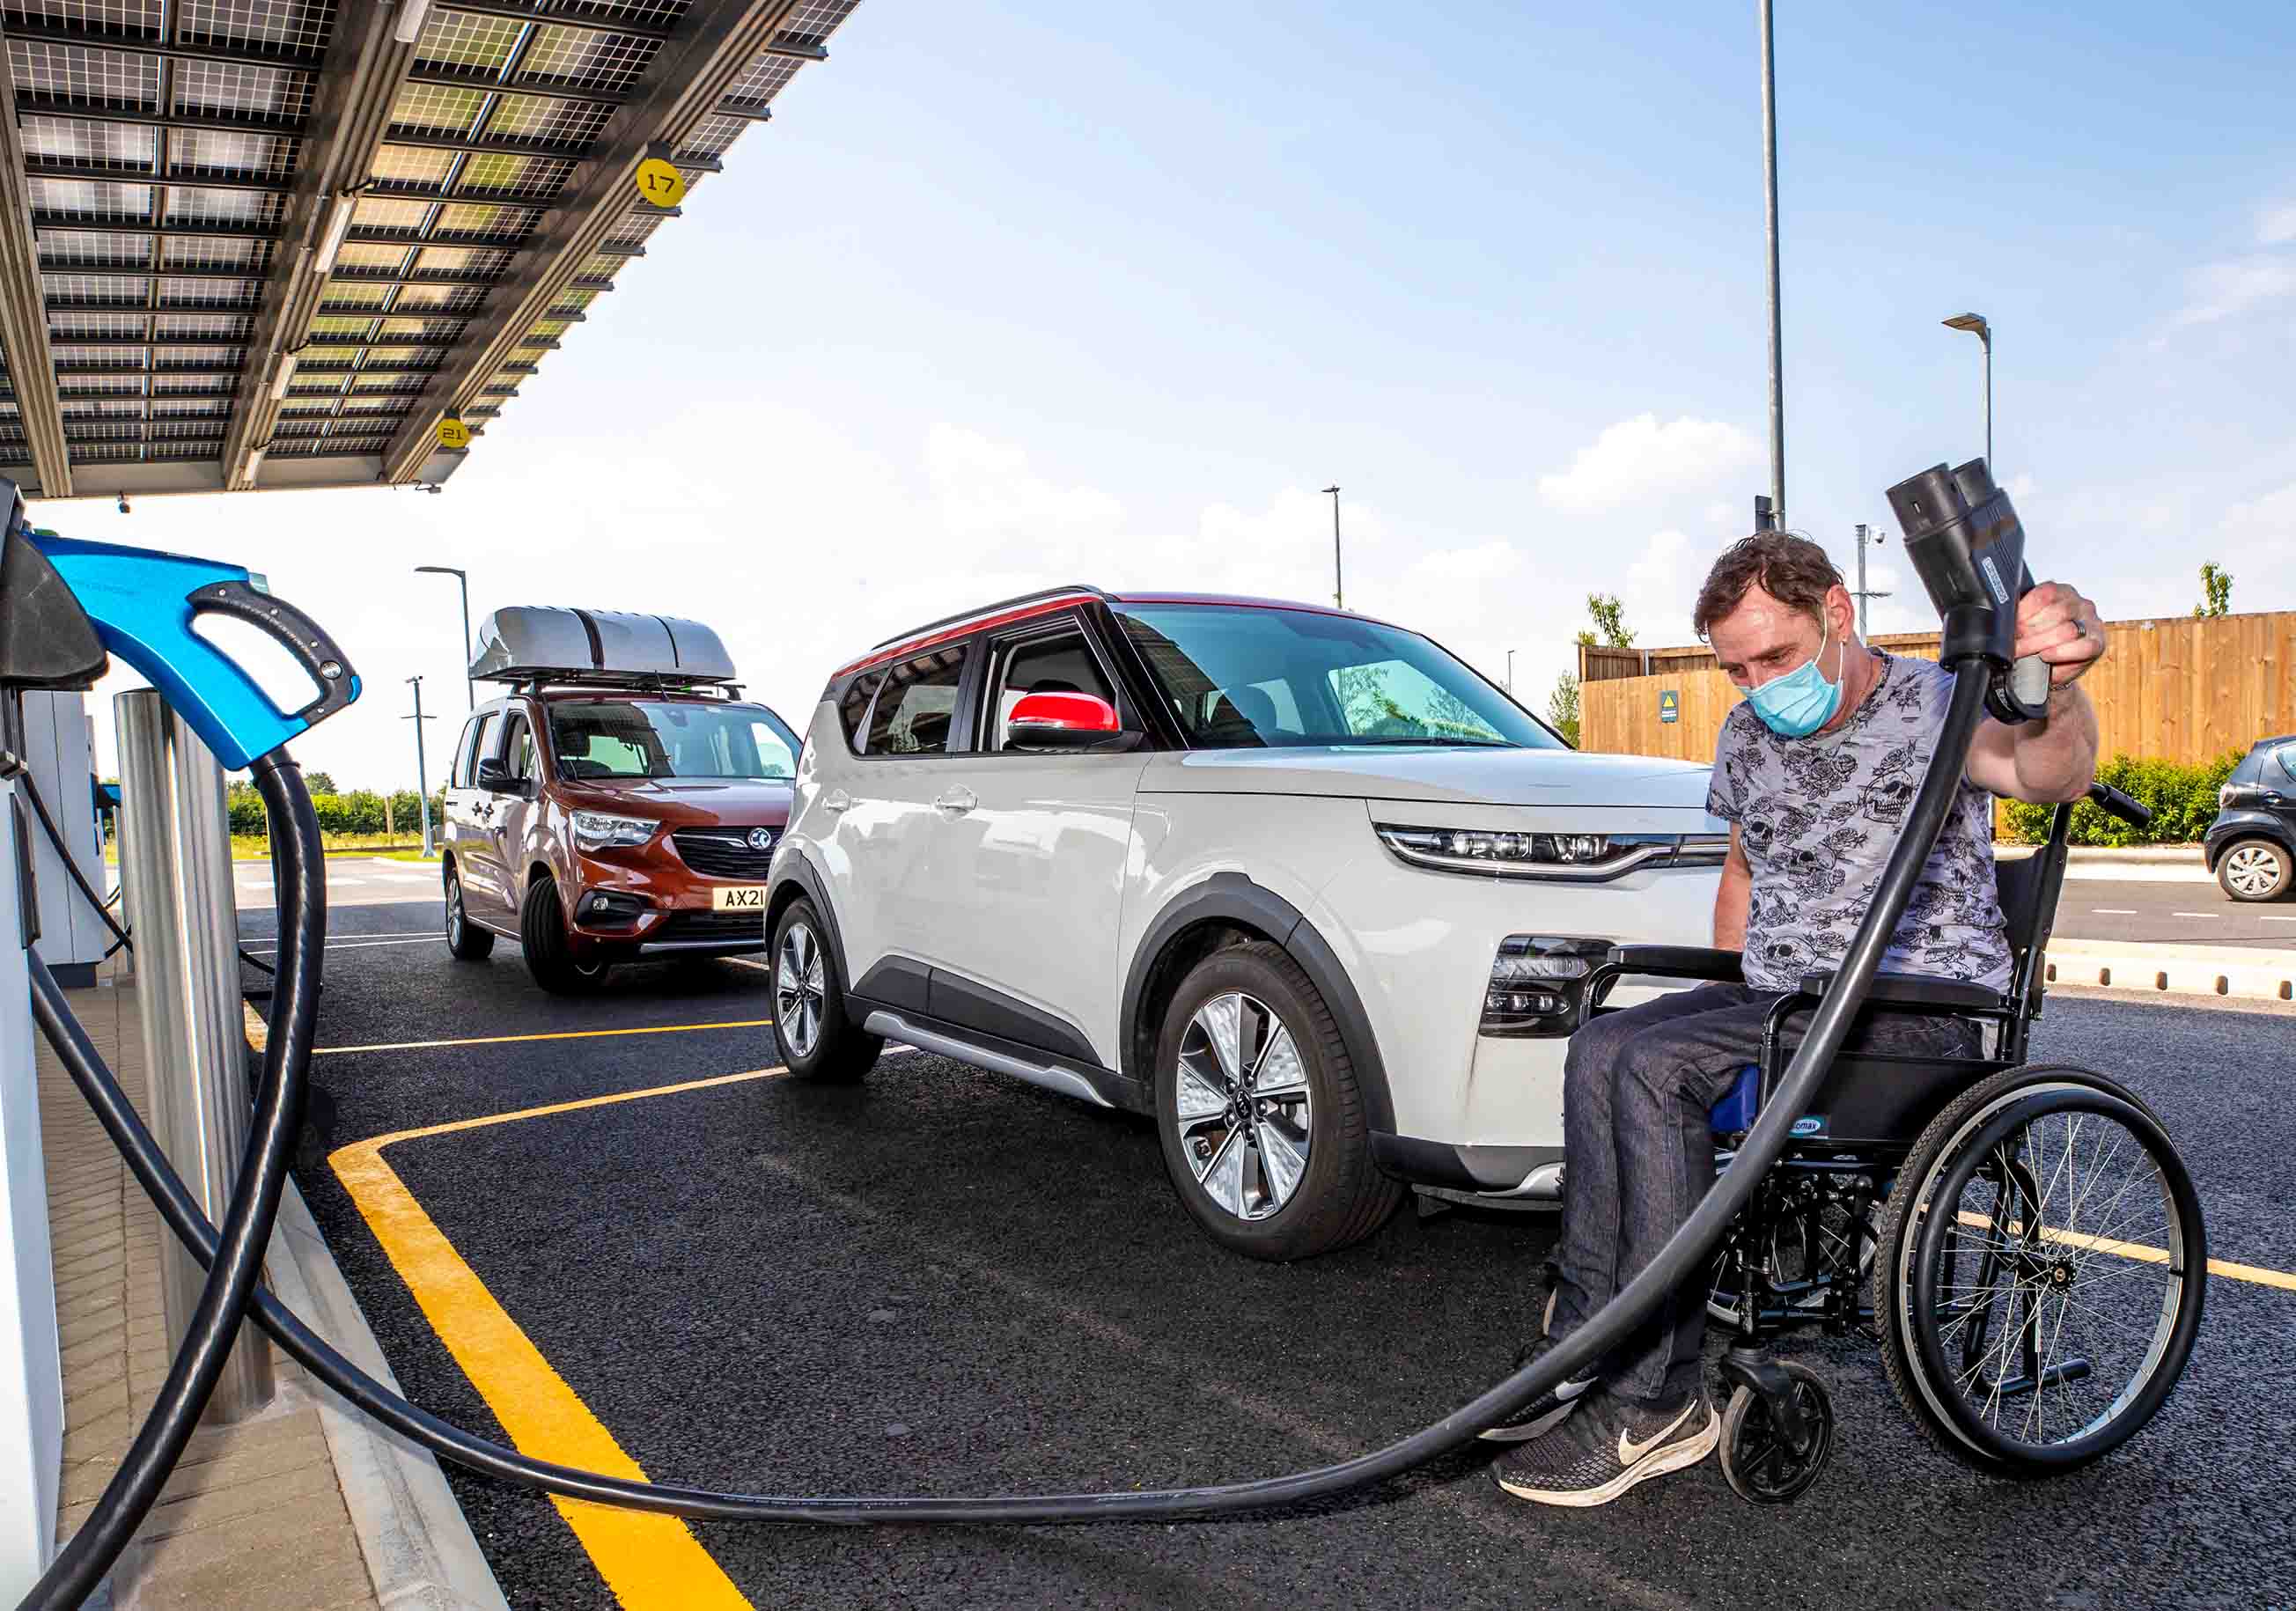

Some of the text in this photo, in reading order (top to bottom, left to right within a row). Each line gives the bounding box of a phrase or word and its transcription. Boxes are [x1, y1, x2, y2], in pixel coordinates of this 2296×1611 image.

[647, 173, 675, 194] 17
[443, 428, 463, 439] 21
[725, 889, 763, 907] AX21
[1795, 1122, 1818, 1130] omax
